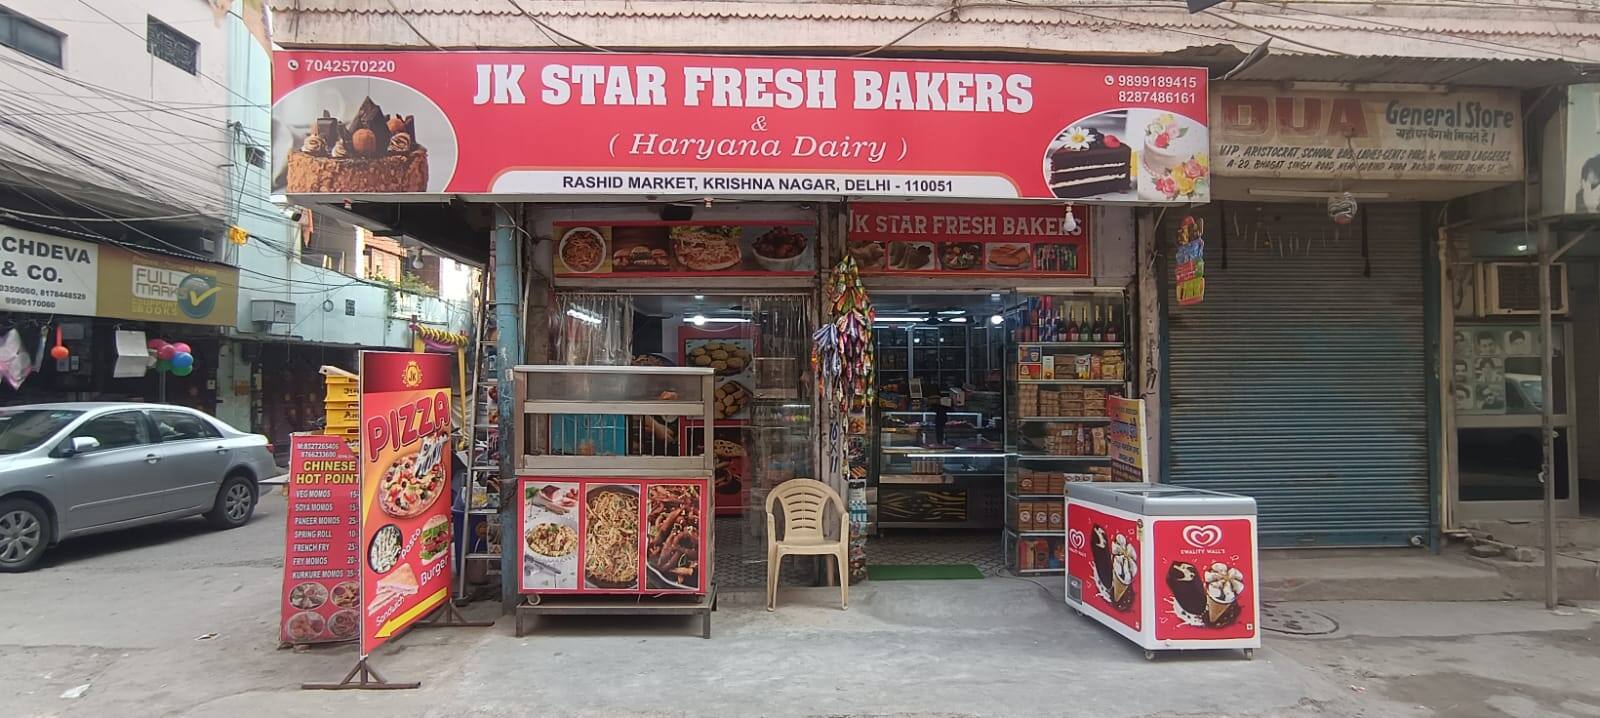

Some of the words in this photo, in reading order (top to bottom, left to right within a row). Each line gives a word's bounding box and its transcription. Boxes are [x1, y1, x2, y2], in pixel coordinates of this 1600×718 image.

[305, 59, 396, 73] 7042570220
[473, 63, 526, 105] JK
[541, 64, 667, 106] STAR
[683, 66, 838, 110] FRESH
[853, 70, 1034, 114] BAKERS
[1118, 75, 1197, 88] 9899189415
[1118, 91, 1196, 104] 8287486161
[1220, 95, 1368, 137] DUA
[1386, 100, 1462, 127] General
[1465, 102, 1514, 128] Store
[751, 115, 768, 131] &
[628, 133, 781, 160] Haryana
[792, 134, 888, 162] Dairy
[563, 175, 623, 188] RASHID
[628, 176, 699, 192] MARKET,
[703, 176, 775, 191] KRISHNA
[778, 178, 840, 193] NAGAR,
[844, 178, 891, 192] DELHI
[904, 180, 953, 193] 110051
[876, 215, 927, 234] STAR
[932, 216, 997, 235] FRESH
[1003, 216, 1082, 237] BAKERS
[0, 236, 91, 264] CHDEVA
[1, 260, 18, 277] &
[27, 264, 63, 283] CO.
[136, 267, 178, 287] FULL
[367, 391, 451, 462] PIZZA
[303, 460, 356, 472] CHINESE
[296, 473, 321, 484] HOT
[324, 473, 360, 484] POINT
[295, 490, 308, 498] VEG
[309, 489, 331, 498] MOMOS
[295, 503, 310, 512] SOYA
[311, 503, 333, 511] MOMOS
[294, 517, 318, 525] PANEER
[318, 516, 341, 525] MOMOS
[294, 530, 316, 538] SPRING
[317, 530, 332, 538] ROLL
[293, 543, 317, 552] FRENCH
[318, 543, 330, 551] FRY
[292, 557, 305, 565] FRY
[305, 557, 328, 565] MOMOS
[322, 569, 344, 578] MOMOS
[420, 556, 448, 586] Burger
